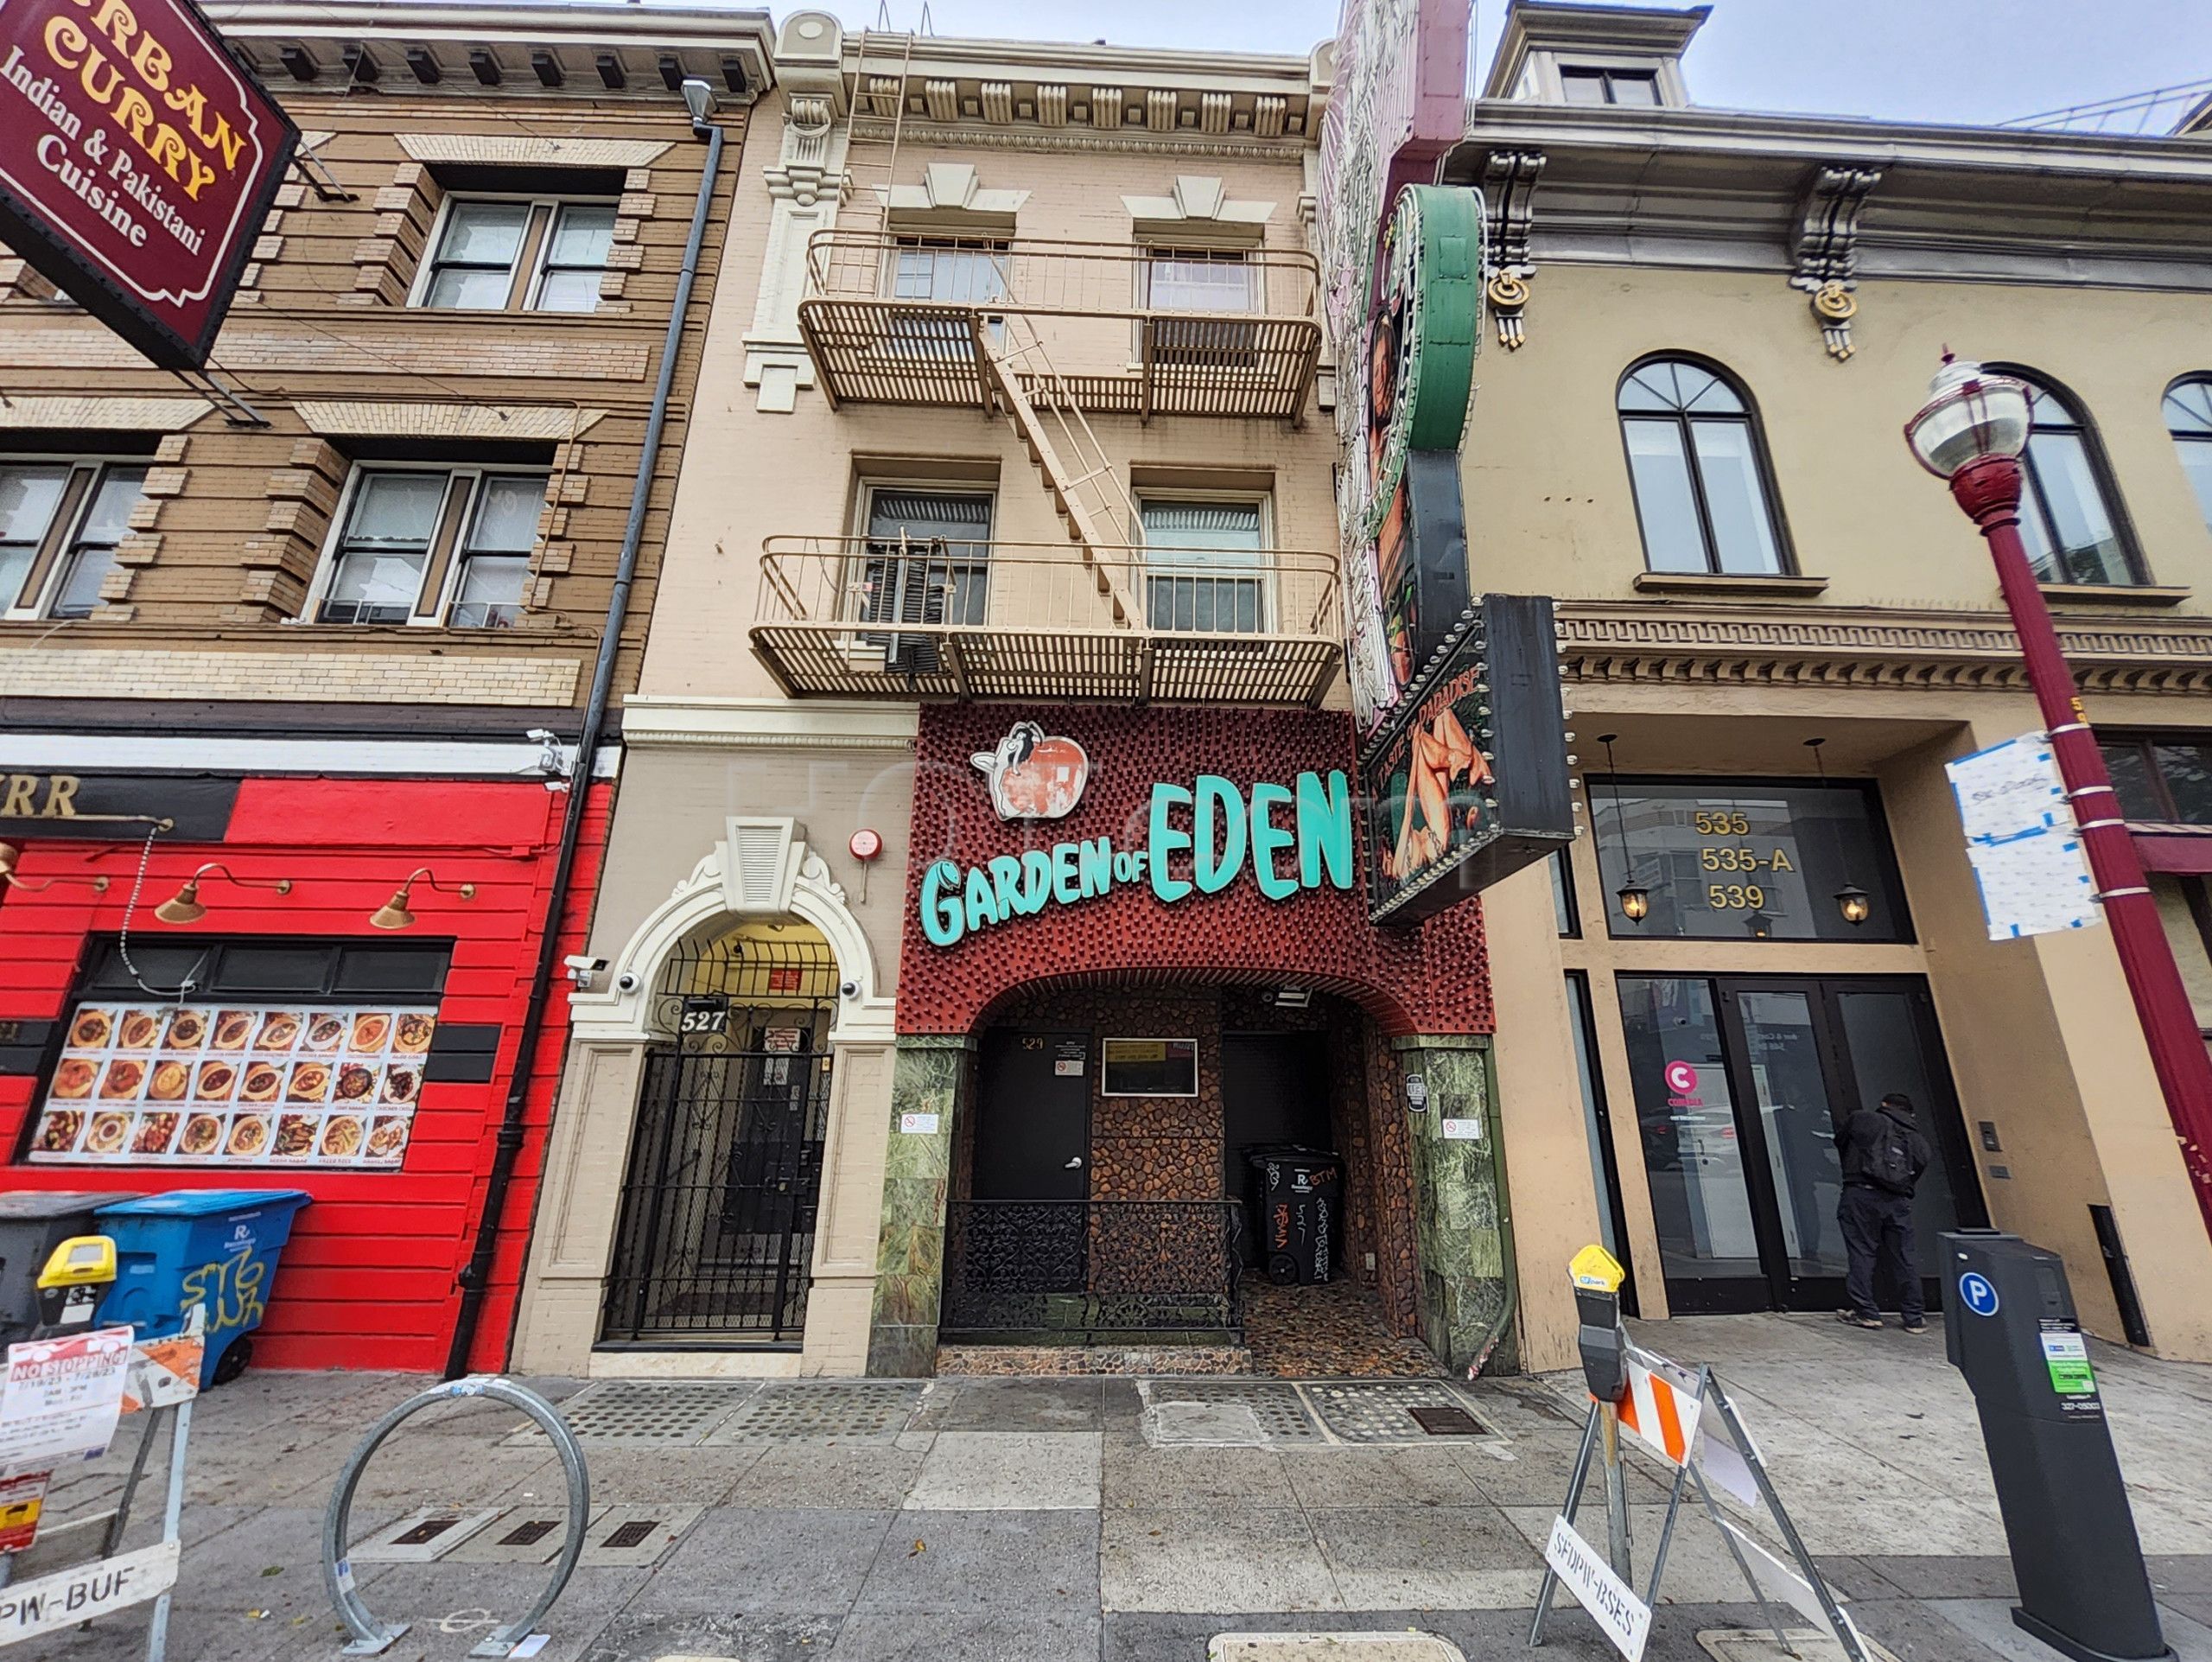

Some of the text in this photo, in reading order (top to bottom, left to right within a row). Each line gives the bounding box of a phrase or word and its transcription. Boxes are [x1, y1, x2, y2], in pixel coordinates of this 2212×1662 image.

[71, 0, 247, 172] RBAN
[44, 16, 216, 201] CURRY
[0, 45, 207, 257] Indian & Pakistani
[36, 134, 149, 248] Cuisine
[1419, 665, 1480, 733] PARADISE
[0, 774, 80, 816] RR
[1694, 812, 1750, 836] 535
[918, 768, 1353, 946] GARDEN OF EDEN
[1701, 849, 1795, 873] 535-A
[1709, 885, 1764, 909] 539
[681, 1010, 727, 1032] 527
[1309, 1167, 1338, 1186] BTM
[1969, 1280, 1987, 1306] P
[10, 1351, 127, 1382] NO STOPPING
[1554, 1532, 1635, 1636] SFDPW-BSES
